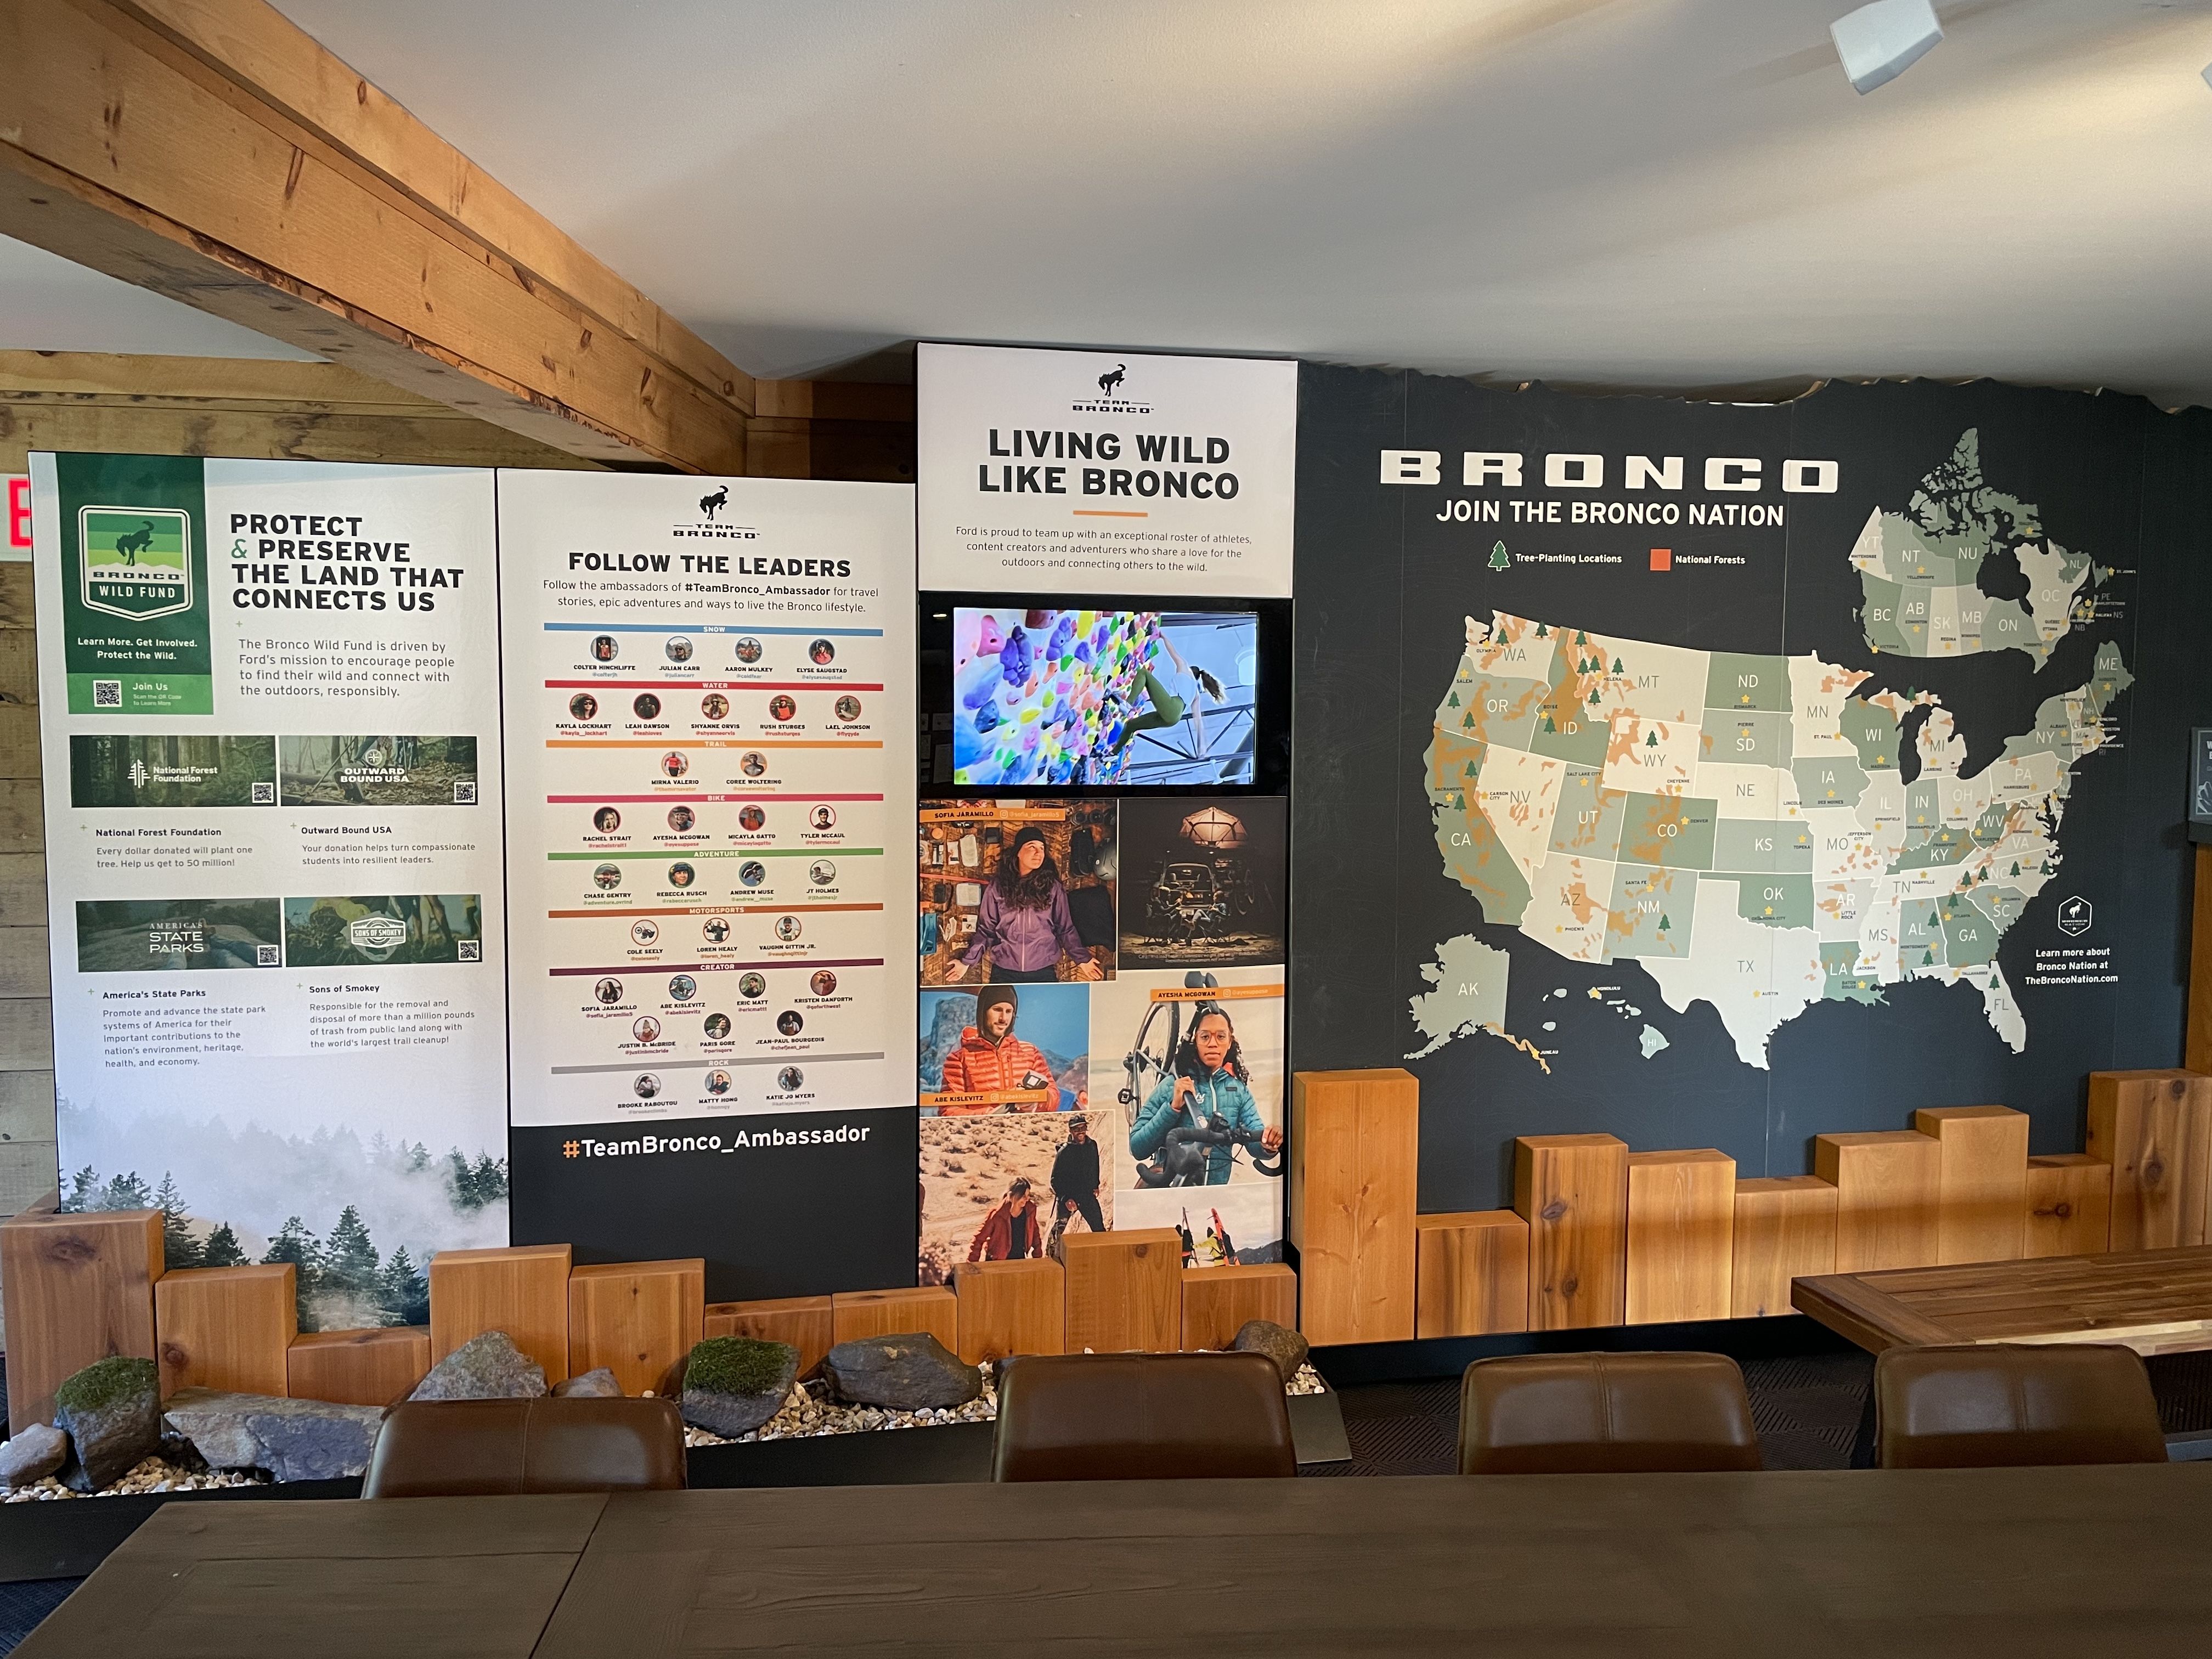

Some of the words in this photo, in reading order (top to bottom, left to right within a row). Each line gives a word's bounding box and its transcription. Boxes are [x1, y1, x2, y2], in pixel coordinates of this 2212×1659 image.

[1073, 404, 1153, 414] BRONCO
[989, 428, 1121, 461] LIVING
[1135, 434, 1229, 464] WILD
[1380, 449, 1839, 493] BRONCO
[979, 464, 1066, 494] LIKE
[1082, 467, 1239, 500] BRONCO
[1436, 499, 1500, 522] JOIN
[1509, 500, 1561, 523] THE
[1571, 501, 1680, 525] BRONCO
[1689, 503, 1784, 527] NATION
[230, 514, 363, 537] PROTECT
[673, 530, 758, 540] BRONCO
[231, 538, 247, 559] &
[258, 539, 410, 563] PRESERVE
[1902, 550, 1920, 562] NT
[1002, 557, 1045, 567] outdoors
[1048, 558, 1065, 568] and
[1068, 560, 1120, 571] connecting
[1123, 560, 1153, 570] others
[1156, 561, 1166, 571] to
[1169, 562, 1184, 571] the
[1187, 563, 1207, 572] wild.
[1515, 552, 1576, 565] Tree-Planting
[1578, 554, 1622, 563] Locations
[1675, 555, 1712, 564] National
[1714, 555, 1746, 565] Forests
[569, 552, 671, 573] FOLLOW
[680, 554, 729, 574] THE
[739, 556, 851, 578] LEADERS
[93, 571, 179, 580] BRONCO
[231, 563, 290, 584] THE
[301, 565, 379, 586] LAND
[390, 567, 464, 589] THAT
[99, 585, 133, 597] WILD
[140, 586, 175, 599] FUND
[544, 579, 576, 590] Follow
[579, 580, 597, 590] the
[600, 581, 668, 592] ambassadors
[672, 582, 681, 592] of
[685, 583, 831, 596] #TeamBronco_Ambassador
[833, 586, 848, 596] for
[851, 588, 878, 597] travel
[233, 588, 386, 611] CONNECTS
[398, 591, 435, 612] US
[1874, 609, 1891, 621] BC
[1999, 620, 2017, 631] ON
[77, 636, 105, 646] Learn
[108, 637, 134, 646] More.
[136, 638, 153, 647] Get
[156, 638, 198, 647] Involved.
[238, 638, 261, 650] The
[266, 639, 309, 650] Bronco
[314, 639, 339, 651] Wild
[344, 640, 372, 651] Fund
[376, 640, 386, 651] is
[390, 641, 428, 652] driven
[432, 641, 446, 654] by
[97, 650, 133, 659] Protect
[135, 651, 151, 659] the
[154, 651, 177, 660] Wild.
[1503, 649, 1526, 662] WA
[239, 654, 276, 665] Ford's
[280, 654, 327, 665] mission
[331, 655, 343, 665] to
[348, 657, 411, 669] encourage
[415, 657, 455, 669] people
[132, 681, 153, 691] Join
[155, 682, 168, 691] Us
[1639, 676, 1659, 688] MT
[1738, 675, 1758, 687] ND
[1487, 699, 1508, 712] OR
[1807, 706, 1828, 719] MN
[1866, 729, 1882, 741] WI
[153, 774, 201, 783] Foundation
[96, 828, 135, 837] National
[138, 828, 167, 837] Forest
[171, 828, 222, 837] Foundation
[301, 826, 339, 834] Outward
[1657, 824, 1678, 837] CO
[1451, 833, 1471, 846] CA
[1827, 838, 1848, 850] MO
[343, 856, 360, 865] into
[363, 856, 397, 865] resilient
[400, 855, 434, 864] leaders.
[1931, 849, 1949, 861] KY
[149, 930, 204, 943] STATE
[354, 929, 368, 938] SONS
[370, 929, 377, 937] OF
[379, 928, 402, 936] SMOKEY
[1959, 929, 1978, 941] GA
[150, 943, 204, 954] PARKS
[2035, 949, 2060, 957] Learn
[2062, 949, 2084, 957] more
[2086, 946, 2111, 956] about
[1737, 961, 1754, 972] TX
[2036, 962, 2067, 972] Bronco
[2069, 961, 2097, 970] Nation
[2099, 960, 2108, 969] at
[2025, 974, 2118, 985] TheBroncoNation.com
[103, 990, 149, 1000] America's
[152, 990, 177, 998] State
[180, 989, 206, 997] Parks
[334, 985, 342, 993] of
[345, 984, 380, 994] Smokey
[1458, 983, 1479, 995] AK
[1994, 998, 2009, 1011] FL
[105, 1059, 136, 1068] health,
[139, 1058, 155, 1067] and
[157, 1058, 200, 1066] economy.
[563, 1124, 870, 1158] #TeamBronco_Ambassador
